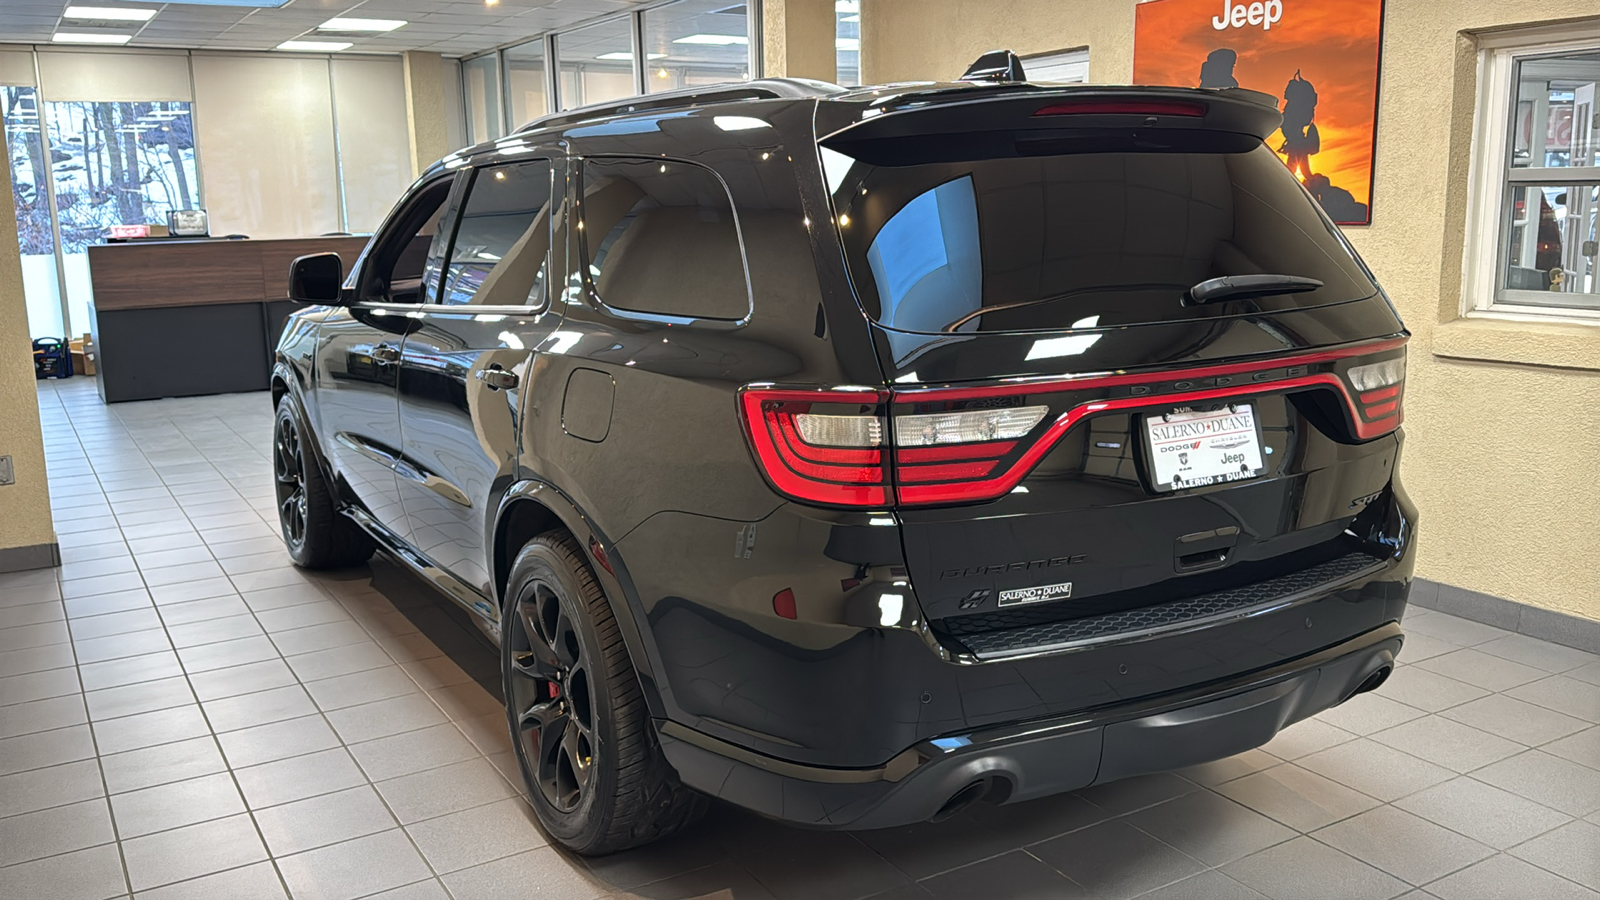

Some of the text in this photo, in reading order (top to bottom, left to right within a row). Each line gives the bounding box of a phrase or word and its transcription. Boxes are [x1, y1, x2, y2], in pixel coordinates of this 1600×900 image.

[1212, 0, 1283, 31] Jeep
[1130, 367, 1301, 395] DODGE
[1152, 415, 1252, 441] SALERNO DUANE
[1220, 452, 1245, 465] Jeep
[1171, 469, 1256, 490] SALERNO DUANE
[939, 553, 1087, 580] DURANGO
[1001, 589, 1036, 601] SALERNO
[1043, 584, 1070, 596] DUANE
